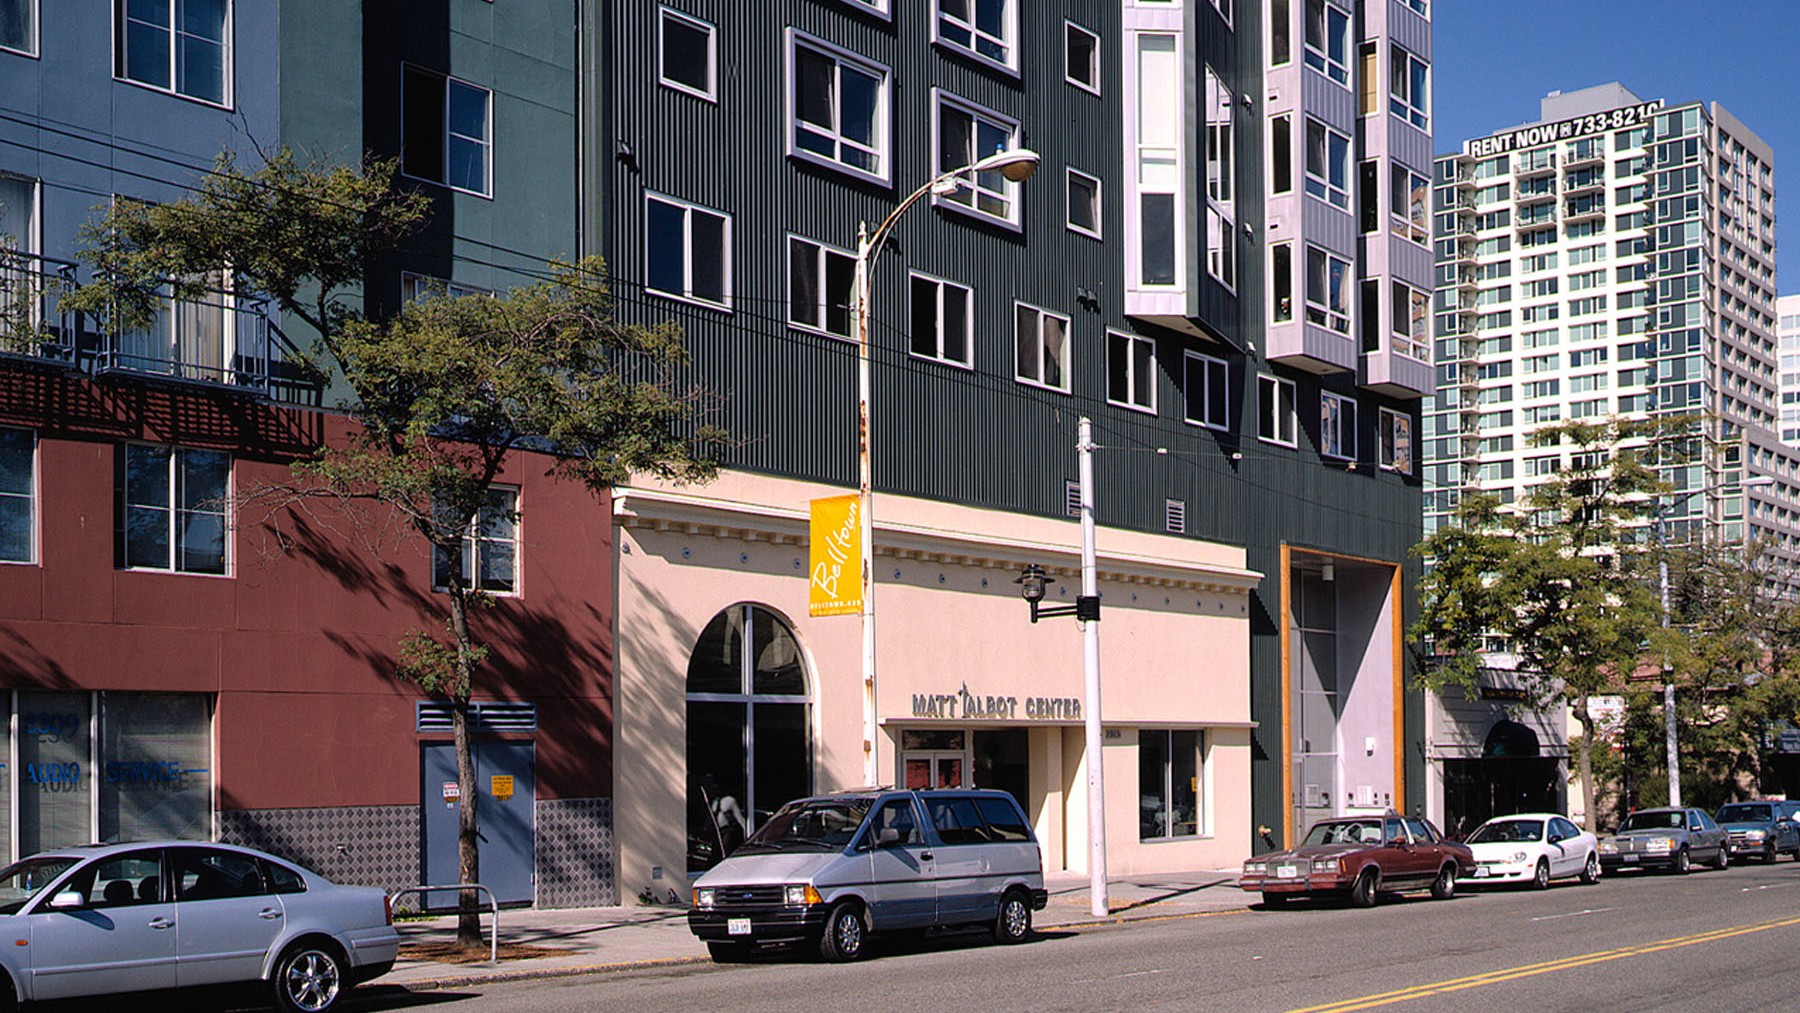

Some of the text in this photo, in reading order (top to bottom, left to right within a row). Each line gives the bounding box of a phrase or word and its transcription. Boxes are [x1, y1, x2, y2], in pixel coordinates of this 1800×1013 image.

[1472, 135, 1512, 157] RENT
[1516, 123, 1560, 148] NOW
[812, 502, 858, 598] Belltown
[912, 680, 1082, 719] MATT TALBOT CENTER
[26, 761, 81, 784] AUDIO
[106, 761, 179, 784] SERVICE
